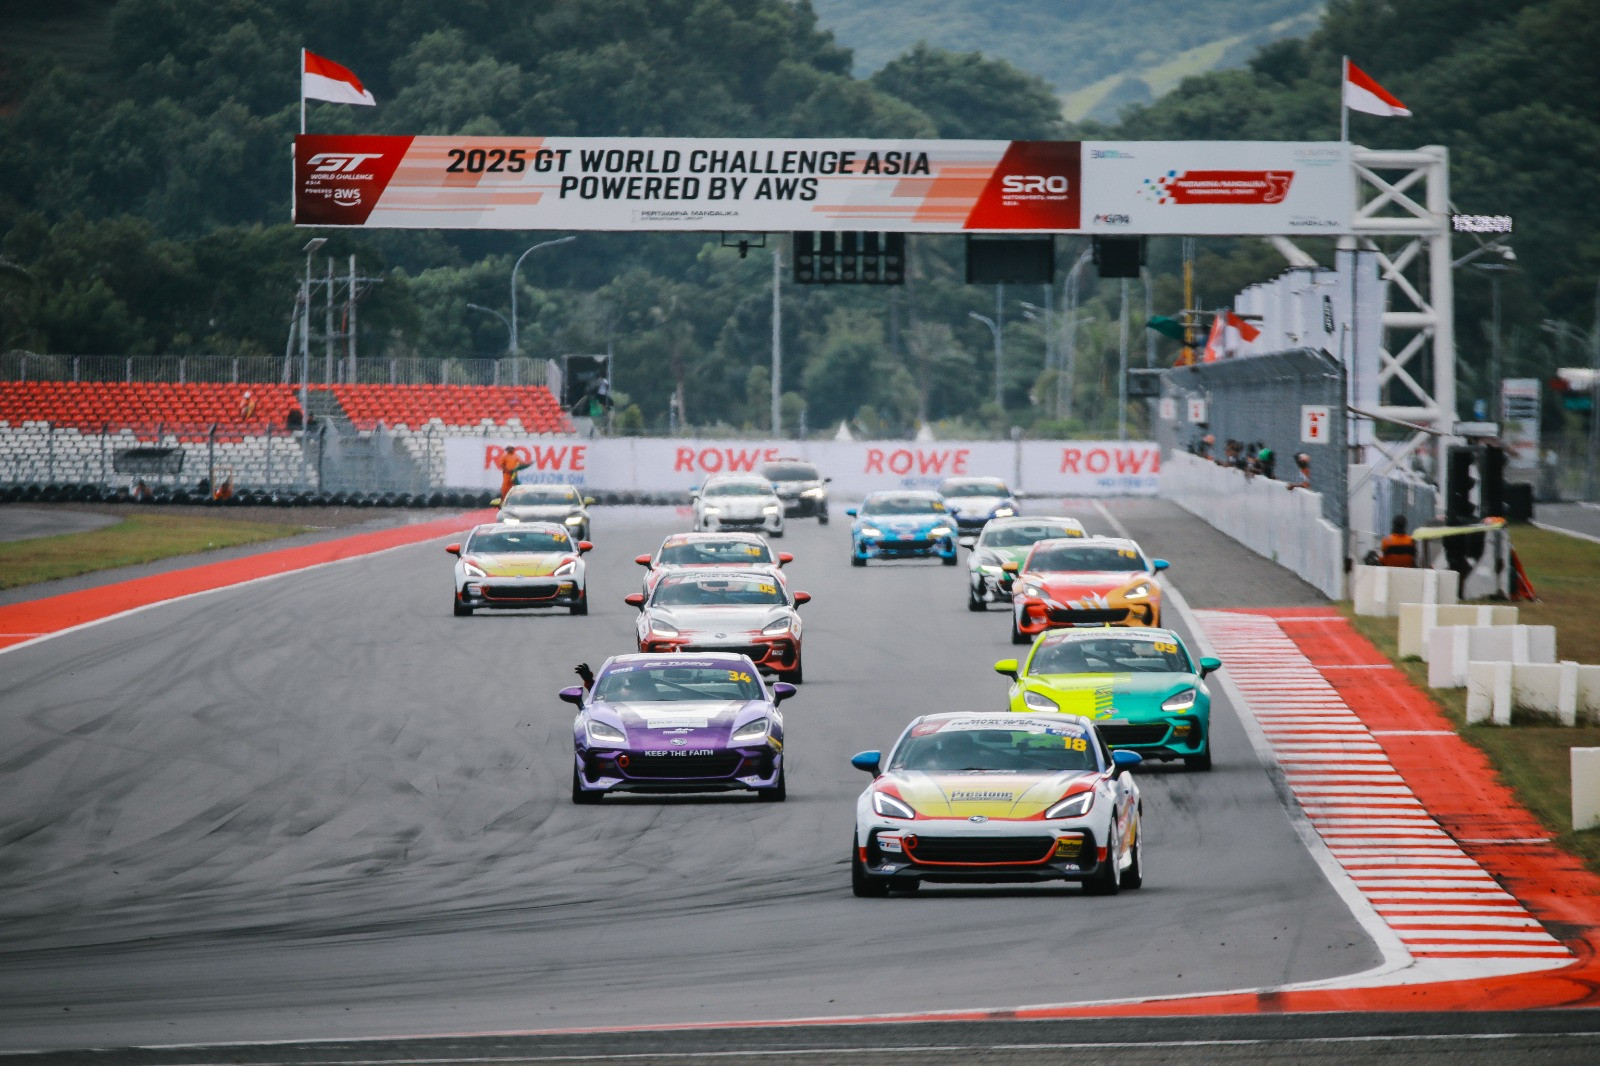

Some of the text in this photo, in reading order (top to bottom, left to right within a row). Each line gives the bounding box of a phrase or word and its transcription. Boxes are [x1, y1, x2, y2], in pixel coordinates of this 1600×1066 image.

[306, 152, 384, 172] GT
[446, 149, 930, 175] 2025 GT WORLD CHALLENGE ASIA
[333, 188, 361, 199] aws
[559, 176, 819, 201] POWERED BY AWS
[1002, 175, 1069, 193] SRO
[484, 445, 588, 471] ROWE
[864, 448, 970, 475] ROWE
[758, 583, 777, 595] 05
[728, 670, 752, 684] 34
[1062, 737, 1087, 752] 18
